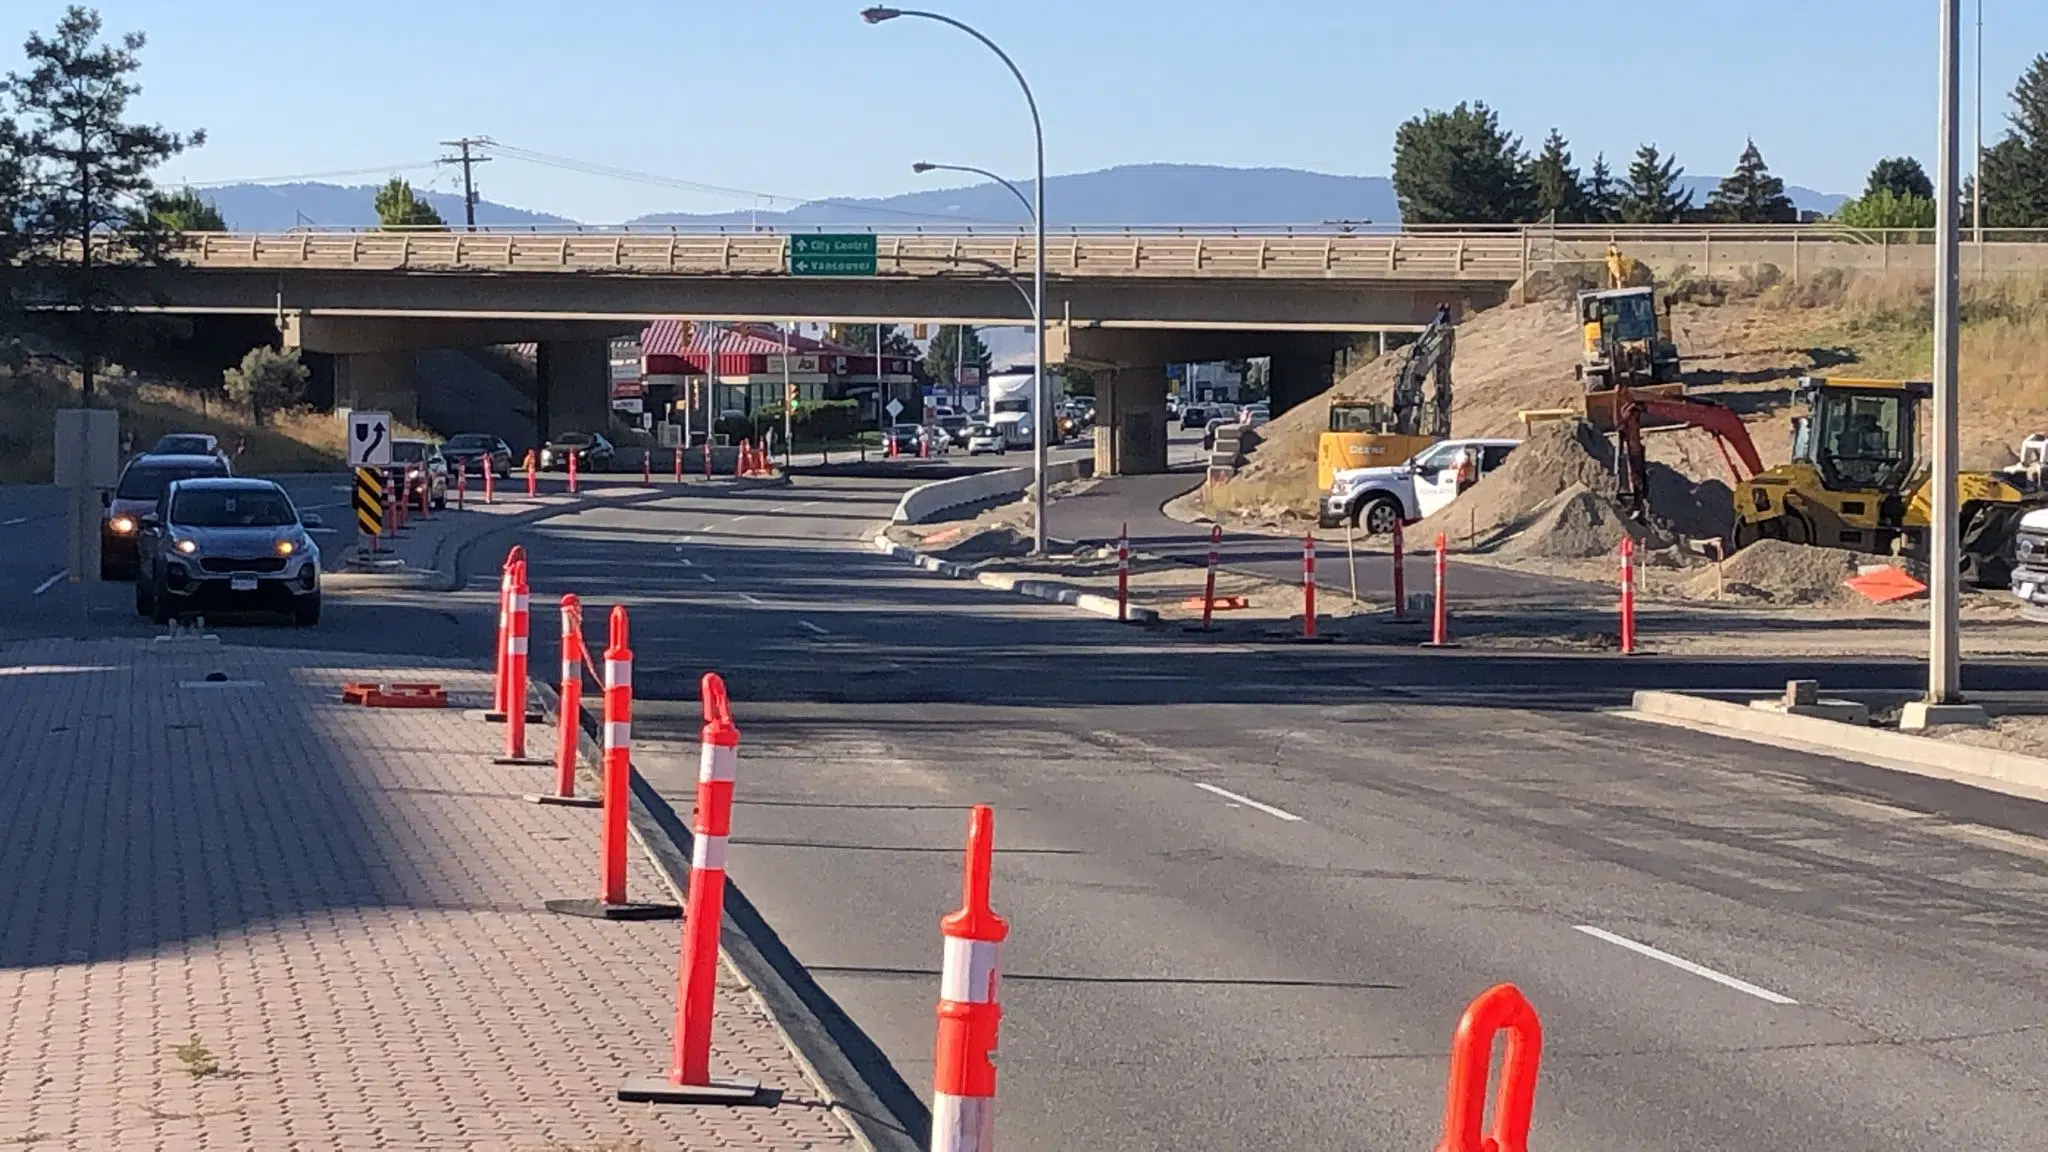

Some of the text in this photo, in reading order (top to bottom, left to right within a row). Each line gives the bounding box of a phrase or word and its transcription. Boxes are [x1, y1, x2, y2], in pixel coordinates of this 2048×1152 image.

[810, 239, 869, 252] City Centre
[811, 260, 871, 271] Vancouver
